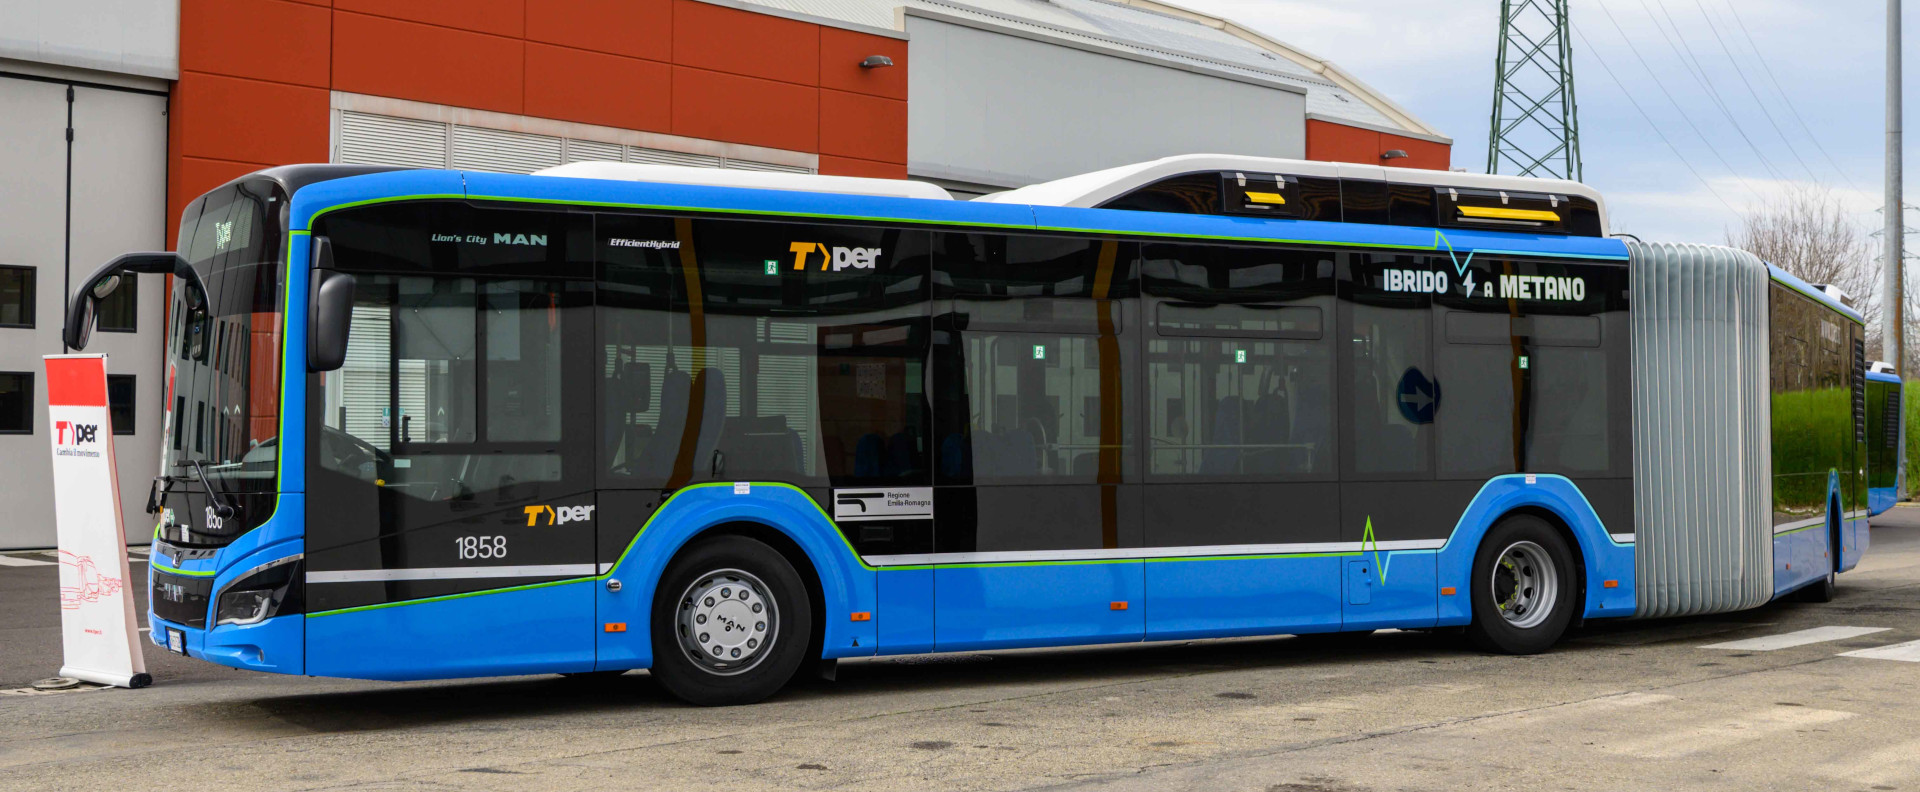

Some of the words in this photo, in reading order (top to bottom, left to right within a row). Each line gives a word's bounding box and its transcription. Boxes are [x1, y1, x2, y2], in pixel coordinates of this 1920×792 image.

[431, 233, 461, 242] Lion's
[466, 235, 487, 244] City
[493, 232, 547, 246] MAN
[610, 238, 680, 249] EfficientHybrid
[1383, 268, 1448, 294] IBRIDO
[1483, 281, 1494, 298] A
[1500, 274, 1586, 302] METANO
[887, 492, 910, 500] Regione
[455, 535, 507, 559] 1858
[717, 614, 745, 632] MAN
